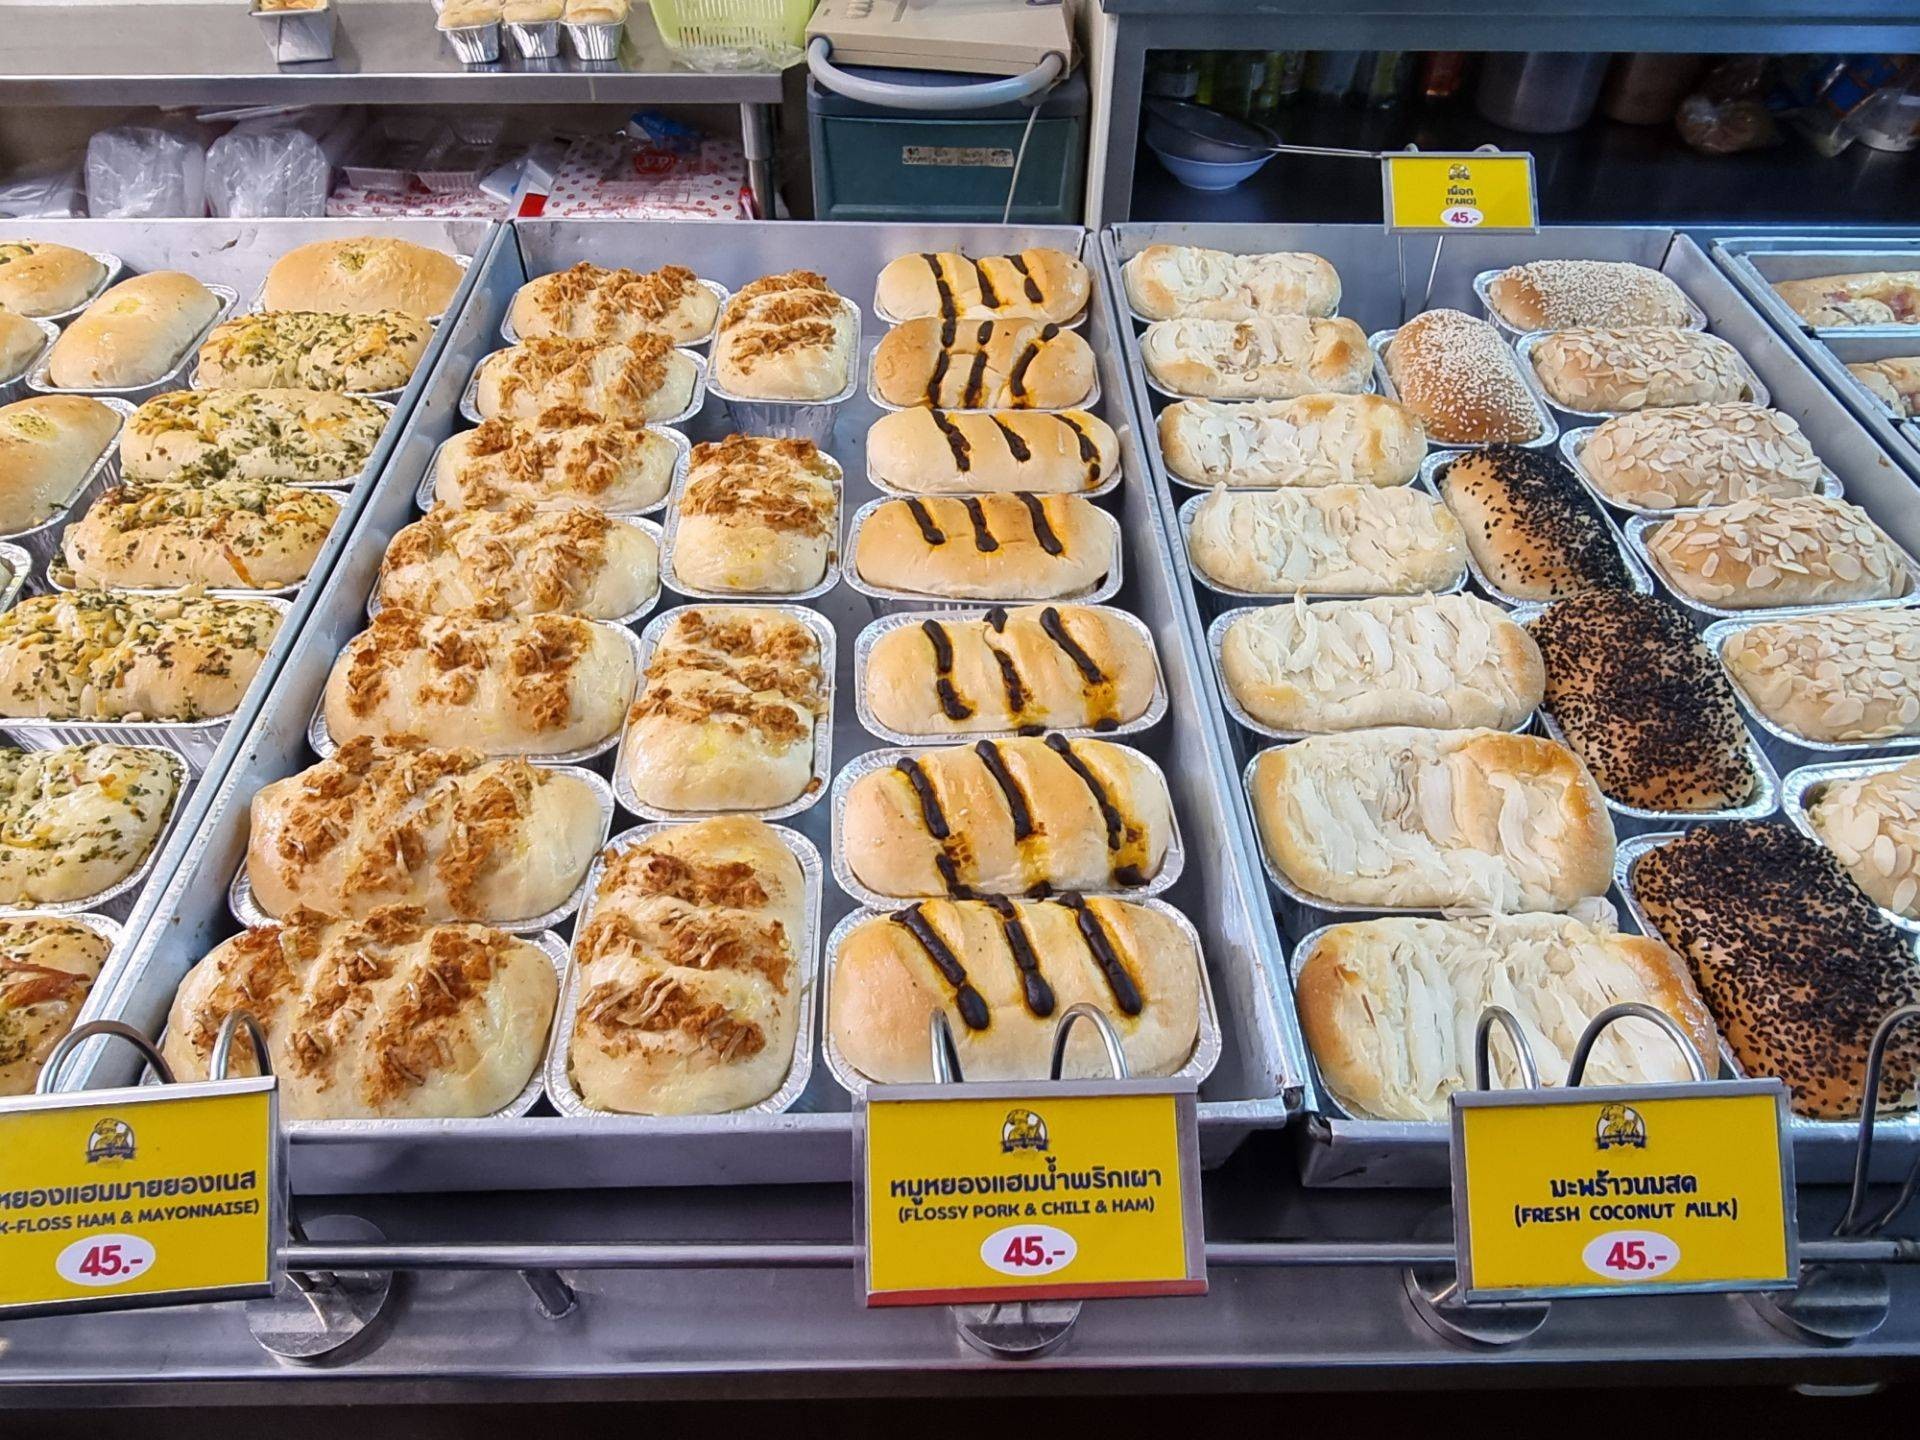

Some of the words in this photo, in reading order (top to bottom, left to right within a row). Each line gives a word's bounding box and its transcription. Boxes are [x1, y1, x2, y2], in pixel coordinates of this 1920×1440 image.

[1446, 197, 1476, 206] (TARO)
[1451, 212, 1478, 224] 45.-
[890, 1156, 1162, 1206] หมูหยองแฮมน้ำพริกเผา
[1549, 1169, 1698, 1198] มะพร้าวนมสด
[77, 1212, 116, 1229] HAM
[120, 1210, 134, 1225] &
[138, 1198, 260, 1223] MAYONNAISE)
[898, 1205, 969, 1224] (FLOSSY
[972, 1203, 1020, 1218] PORK
[1024, 1202, 1037, 1217] &
[1041, 1200, 1091, 1216] CHILI
[1094, 1199, 1108, 1214] &
[1112, 1196, 1155, 1213] HAM)
[1514, 1204, 1581, 1228] (FRESH
[1589, 1202, 1676, 1221] COCONUT
[1685, 1197, 1738, 1221] MILK)
[78, 1244, 144, 1277] 45.-
[1002, 1235, 1066, 1267] 45.-
[1605, 1240, 1668, 1271] 45.-
